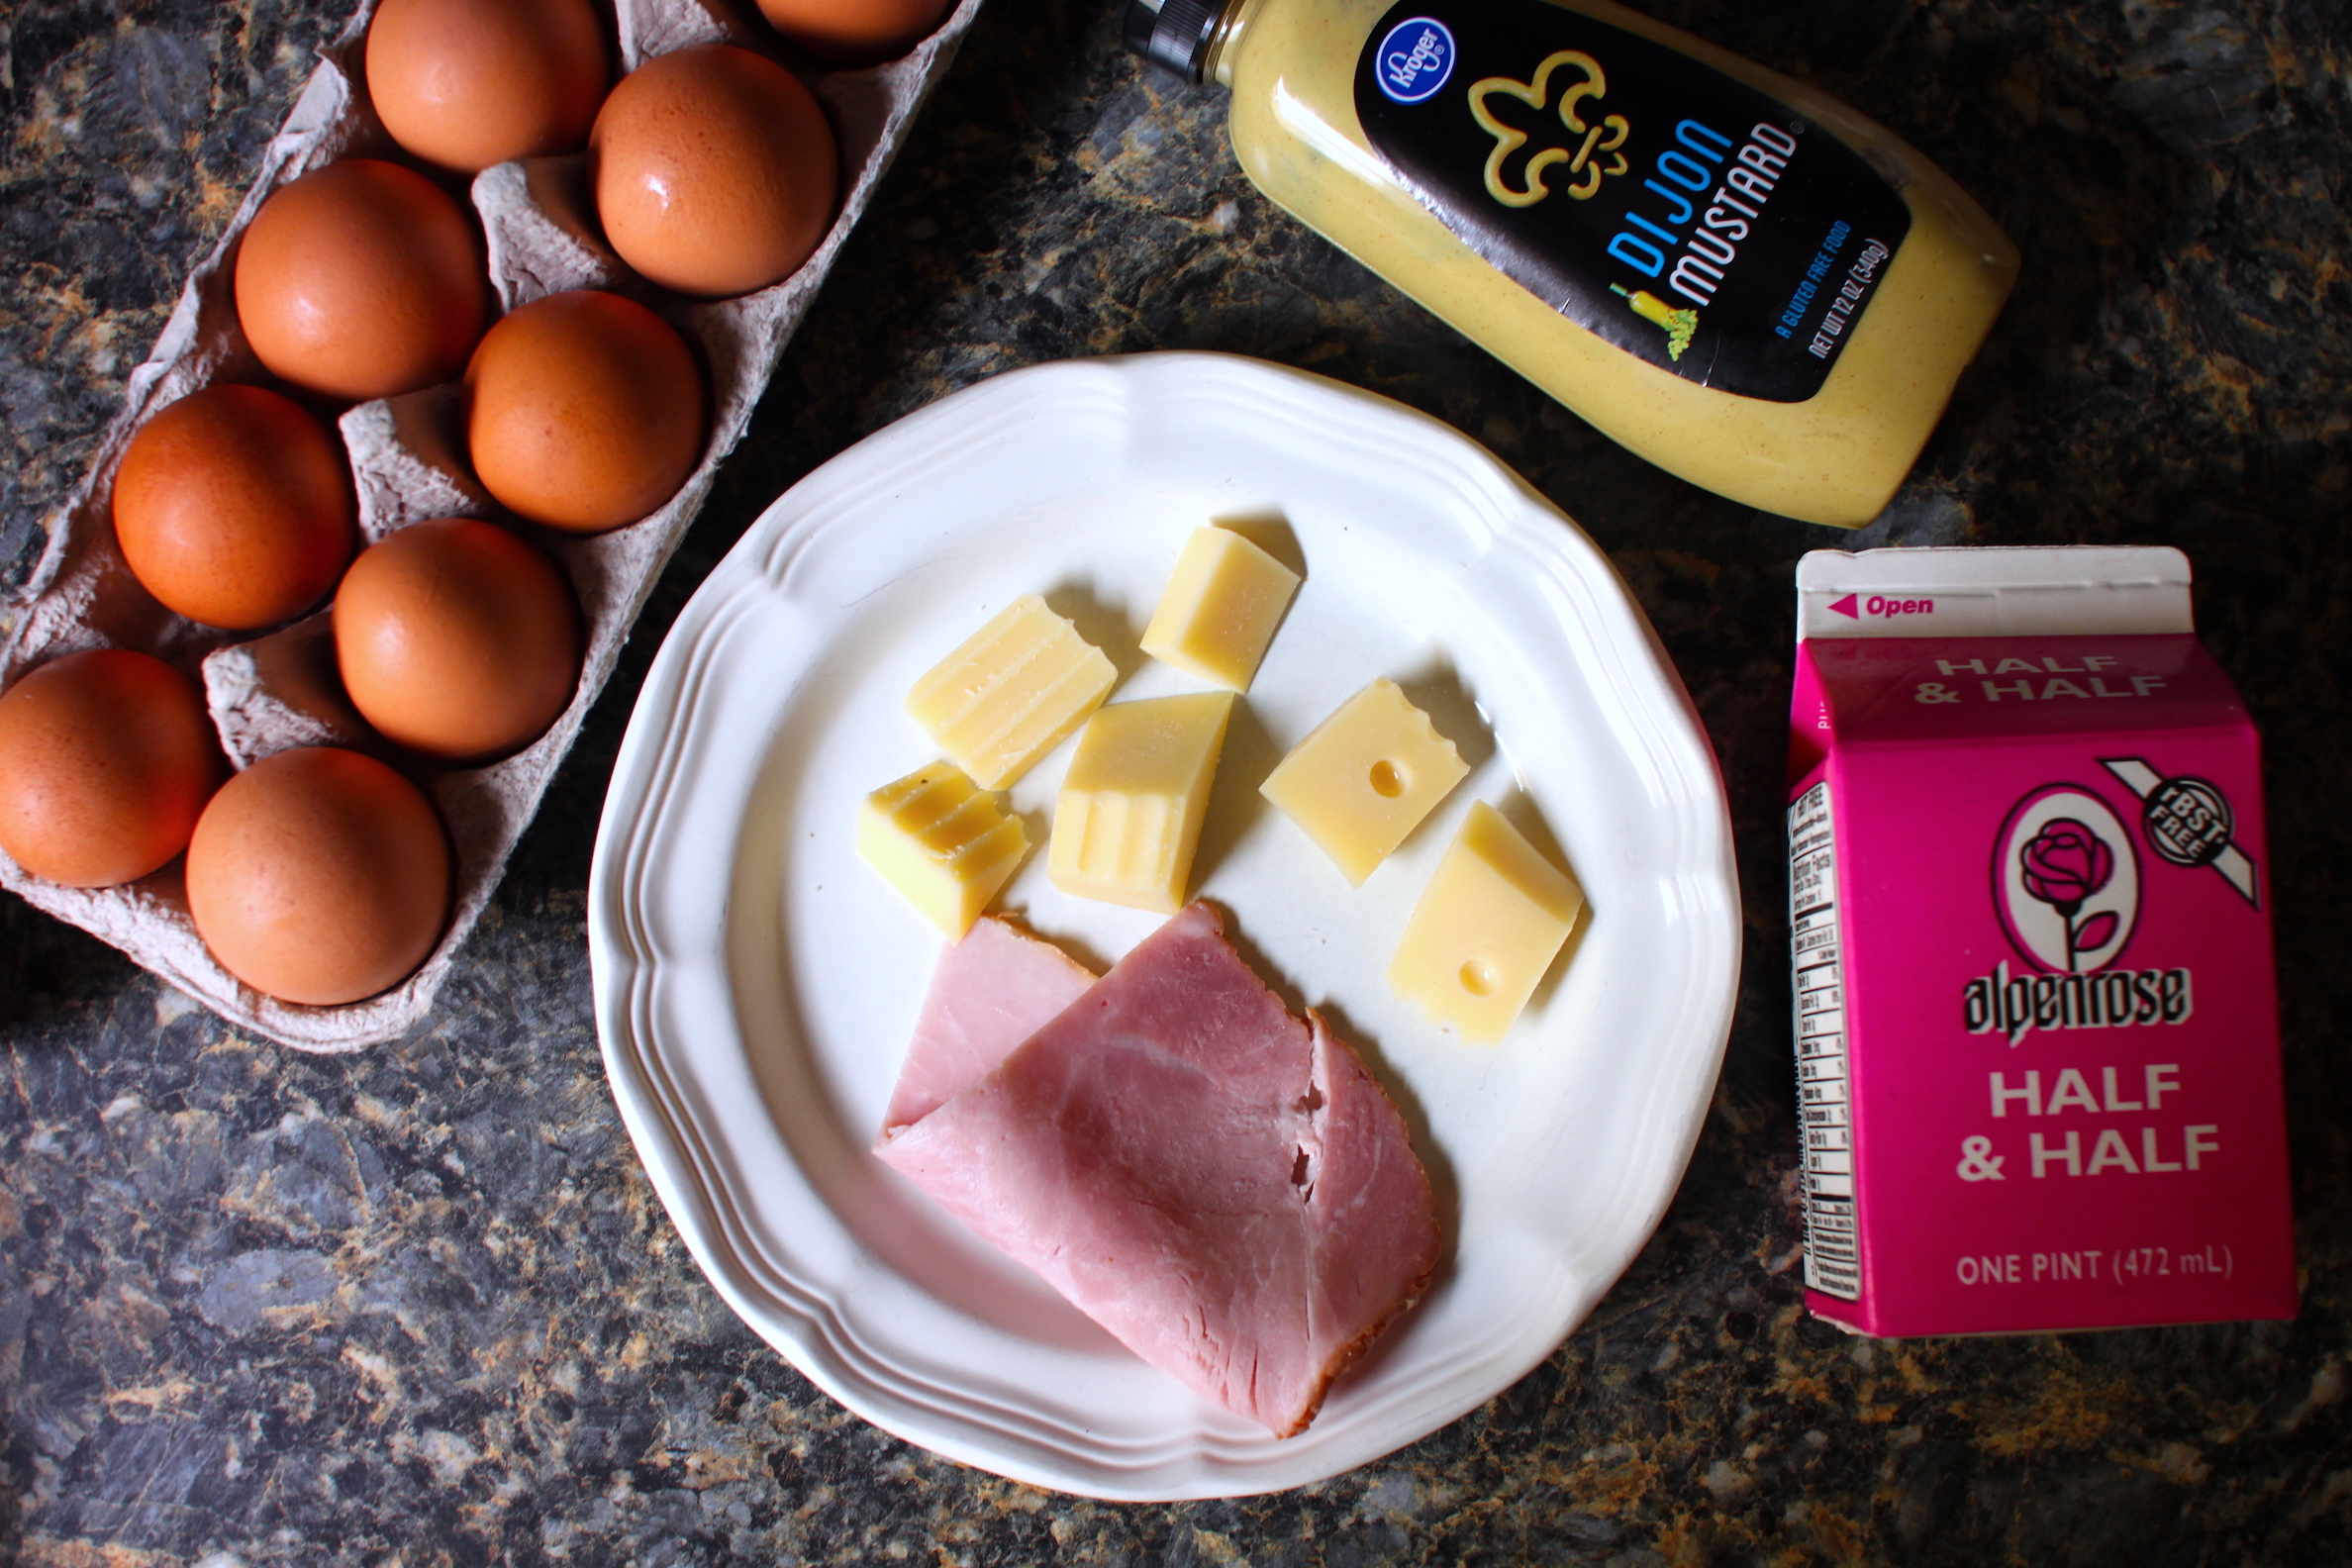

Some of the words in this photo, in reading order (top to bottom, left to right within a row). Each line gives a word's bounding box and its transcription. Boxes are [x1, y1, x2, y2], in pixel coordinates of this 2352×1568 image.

[1388, 27, 1439, 89] Kroger
[1607, 119, 1733, 278] DIJON
[1668, 122, 1798, 308] MUSTARD
[1822, 220, 1852, 254] FOOD
[1807, 250, 1834, 283] FREE
[1848, 238, 1890, 284] (340g)
[1781, 279, 1818, 328] GLUTEN
[1831, 296, 1856, 316] 12
[1840, 278, 1865, 301] OZ
[1775, 325, 1793, 340] A
[1819, 310, 1846, 337] WT
[1808, 330, 1835, 359] NET
[1865, 596, 1934, 617] Open
[1935, 656, 2118, 676] HALF
[1914, 682, 1963, 704] &
[1981, 676, 2166, 702] HALF
[2148, 804, 2207, 859] FREE
[1963, 959, 2194, 1049] alpenrose
[1989, 1063, 2182, 1119] HALF
[1956, 1134, 2007, 1182] &
[2029, 1125, 2220, 1179] HALF
[1956, 1255, 2022, 1286] ONE
[2032, 1250, 2104, 1282] PINT
[2112, 1246, 2172, 1287] (472
[2180, 1243, 2234, 1281] mL)
